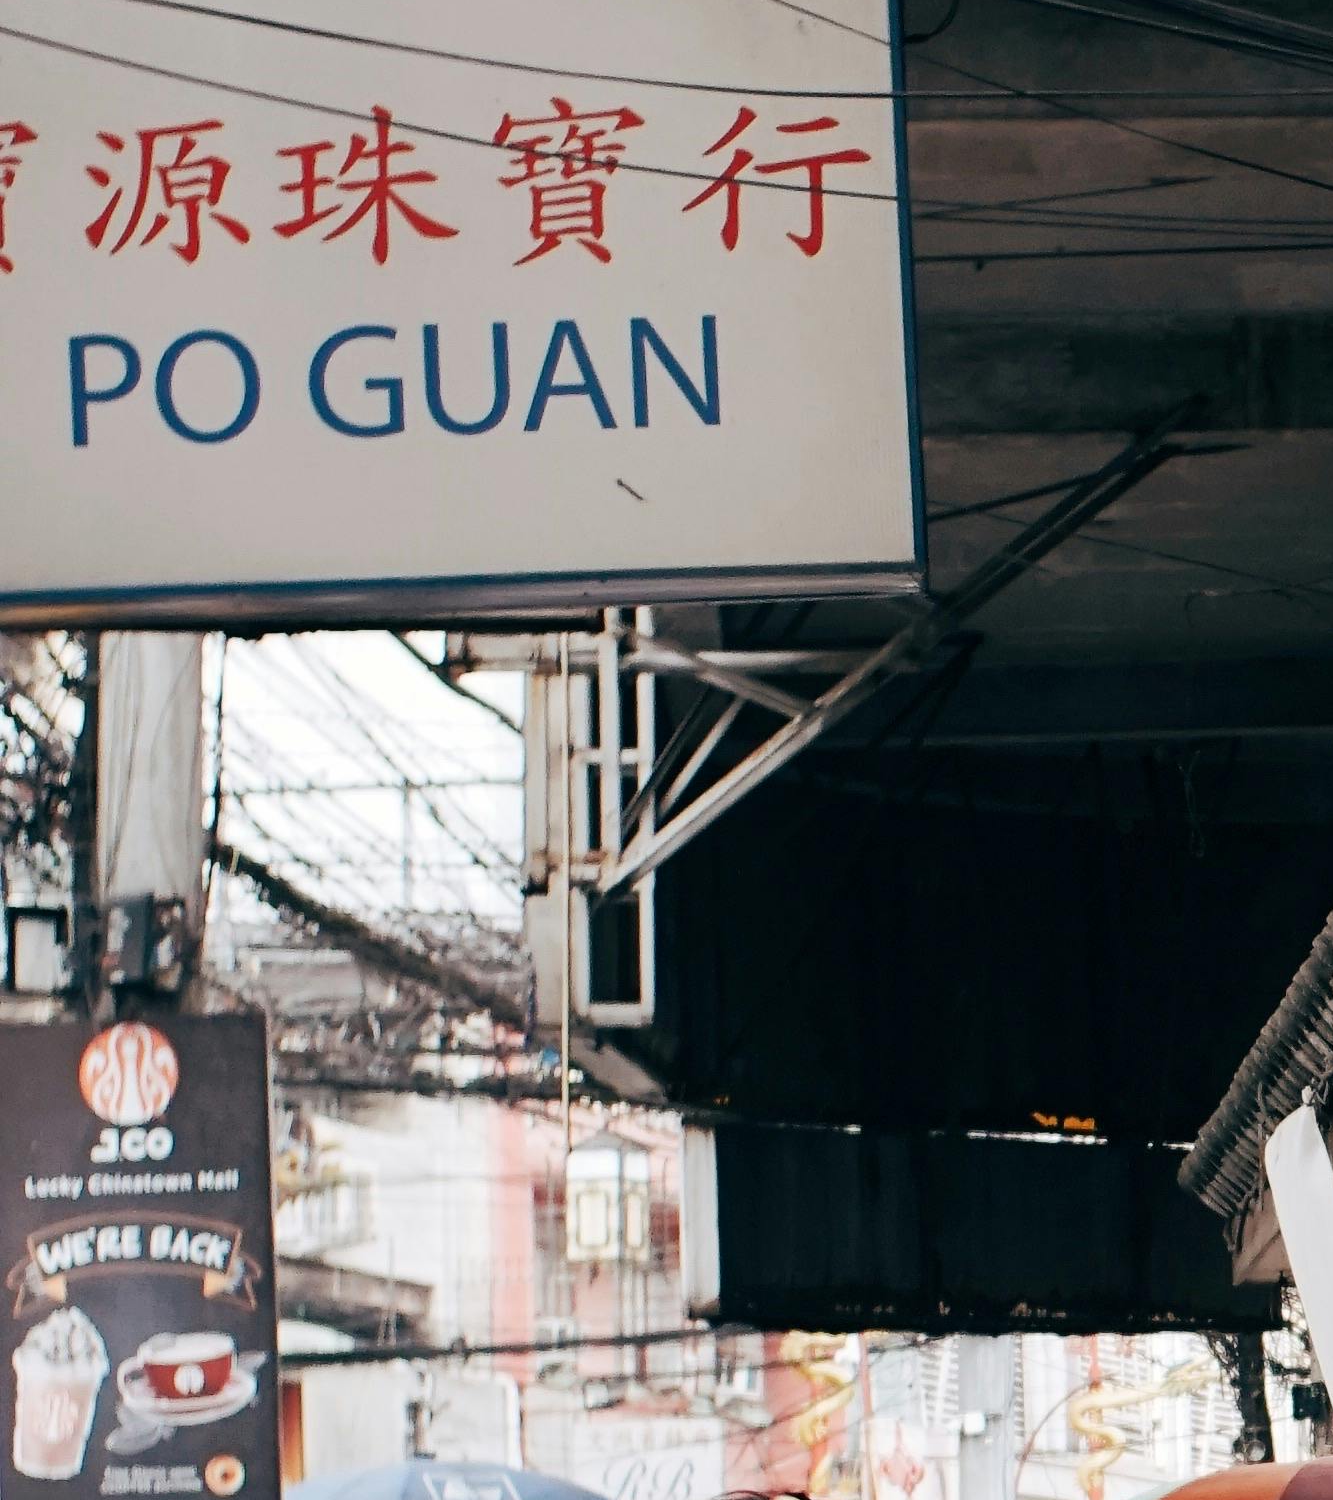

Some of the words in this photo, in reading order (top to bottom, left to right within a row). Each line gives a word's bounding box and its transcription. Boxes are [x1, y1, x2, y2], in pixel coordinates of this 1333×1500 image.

[0, 95, 872, 272] 源珠寶行
[68, 328, 261, 447] PO
[308, 314, 721, 439] GUAN
[24, 1173, 84, 1201] Lucky
[88, 1172, 193, 1197] Chinatown
[197, 1168, 240, 1192] Mall
[36, 1224, 143, 1275] WE'RE
[150, 1224, 232, 1269] BACK
